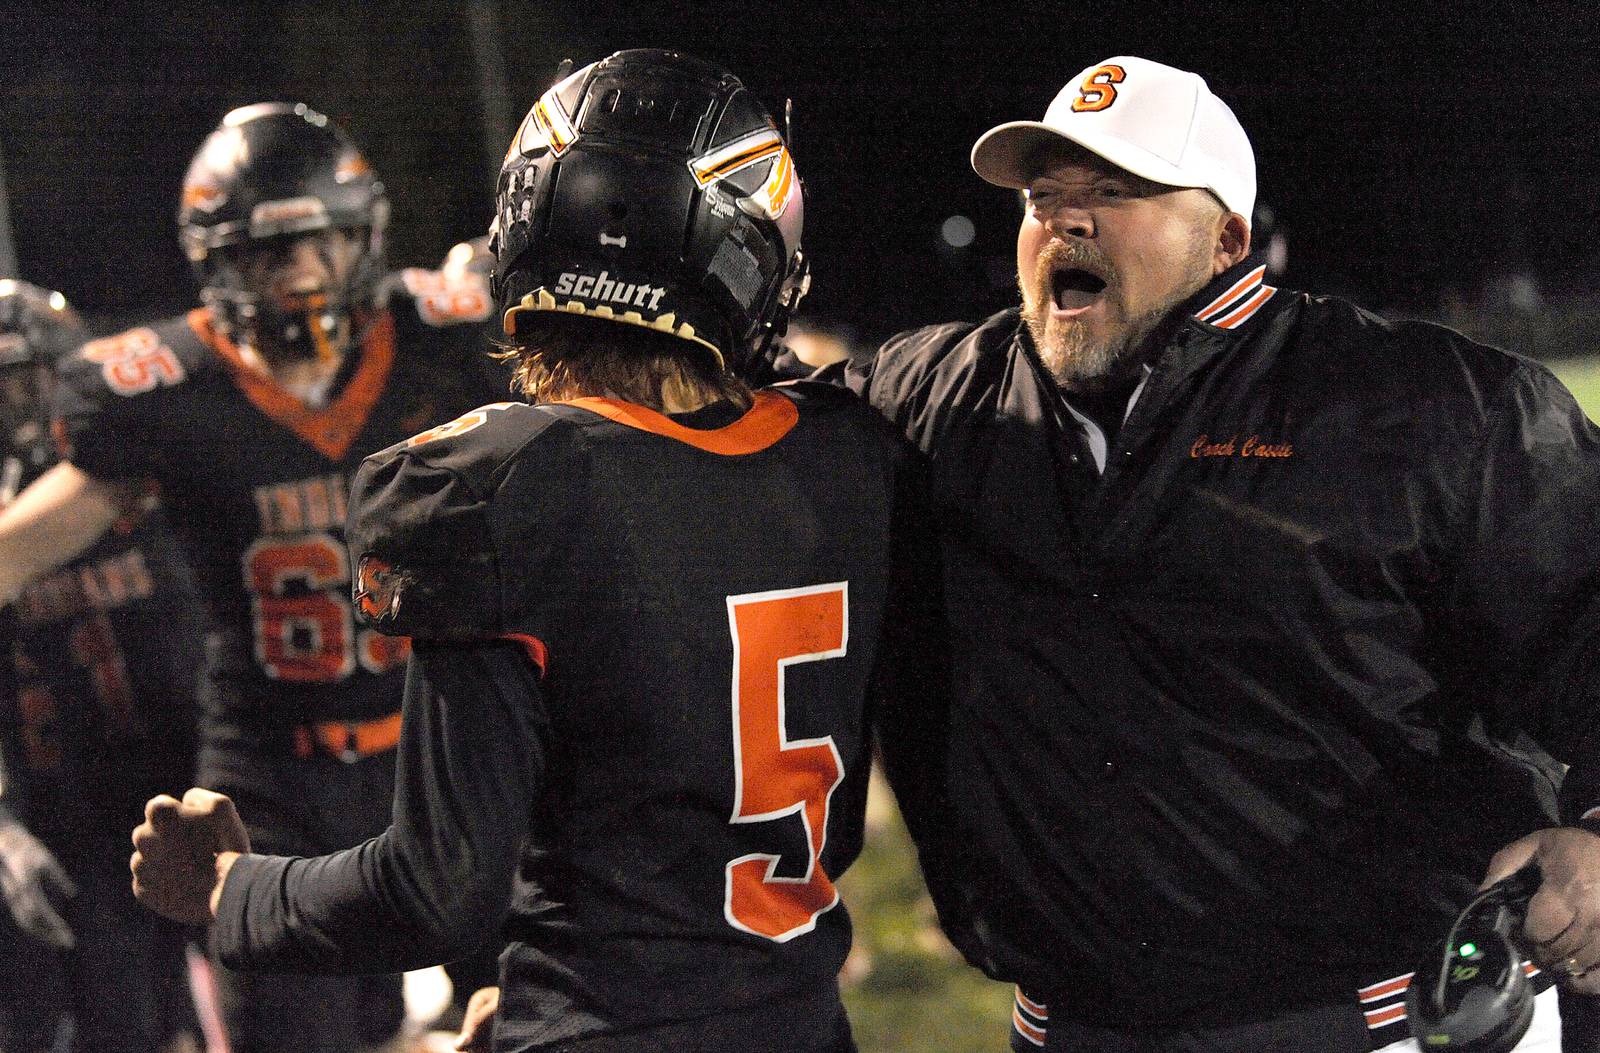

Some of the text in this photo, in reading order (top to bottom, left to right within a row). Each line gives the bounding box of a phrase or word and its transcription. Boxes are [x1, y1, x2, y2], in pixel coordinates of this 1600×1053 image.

[1070, 64, 1127, 113] S
[555, 270, 666, 311] schutt
[724, 581, 849, 944] 5
